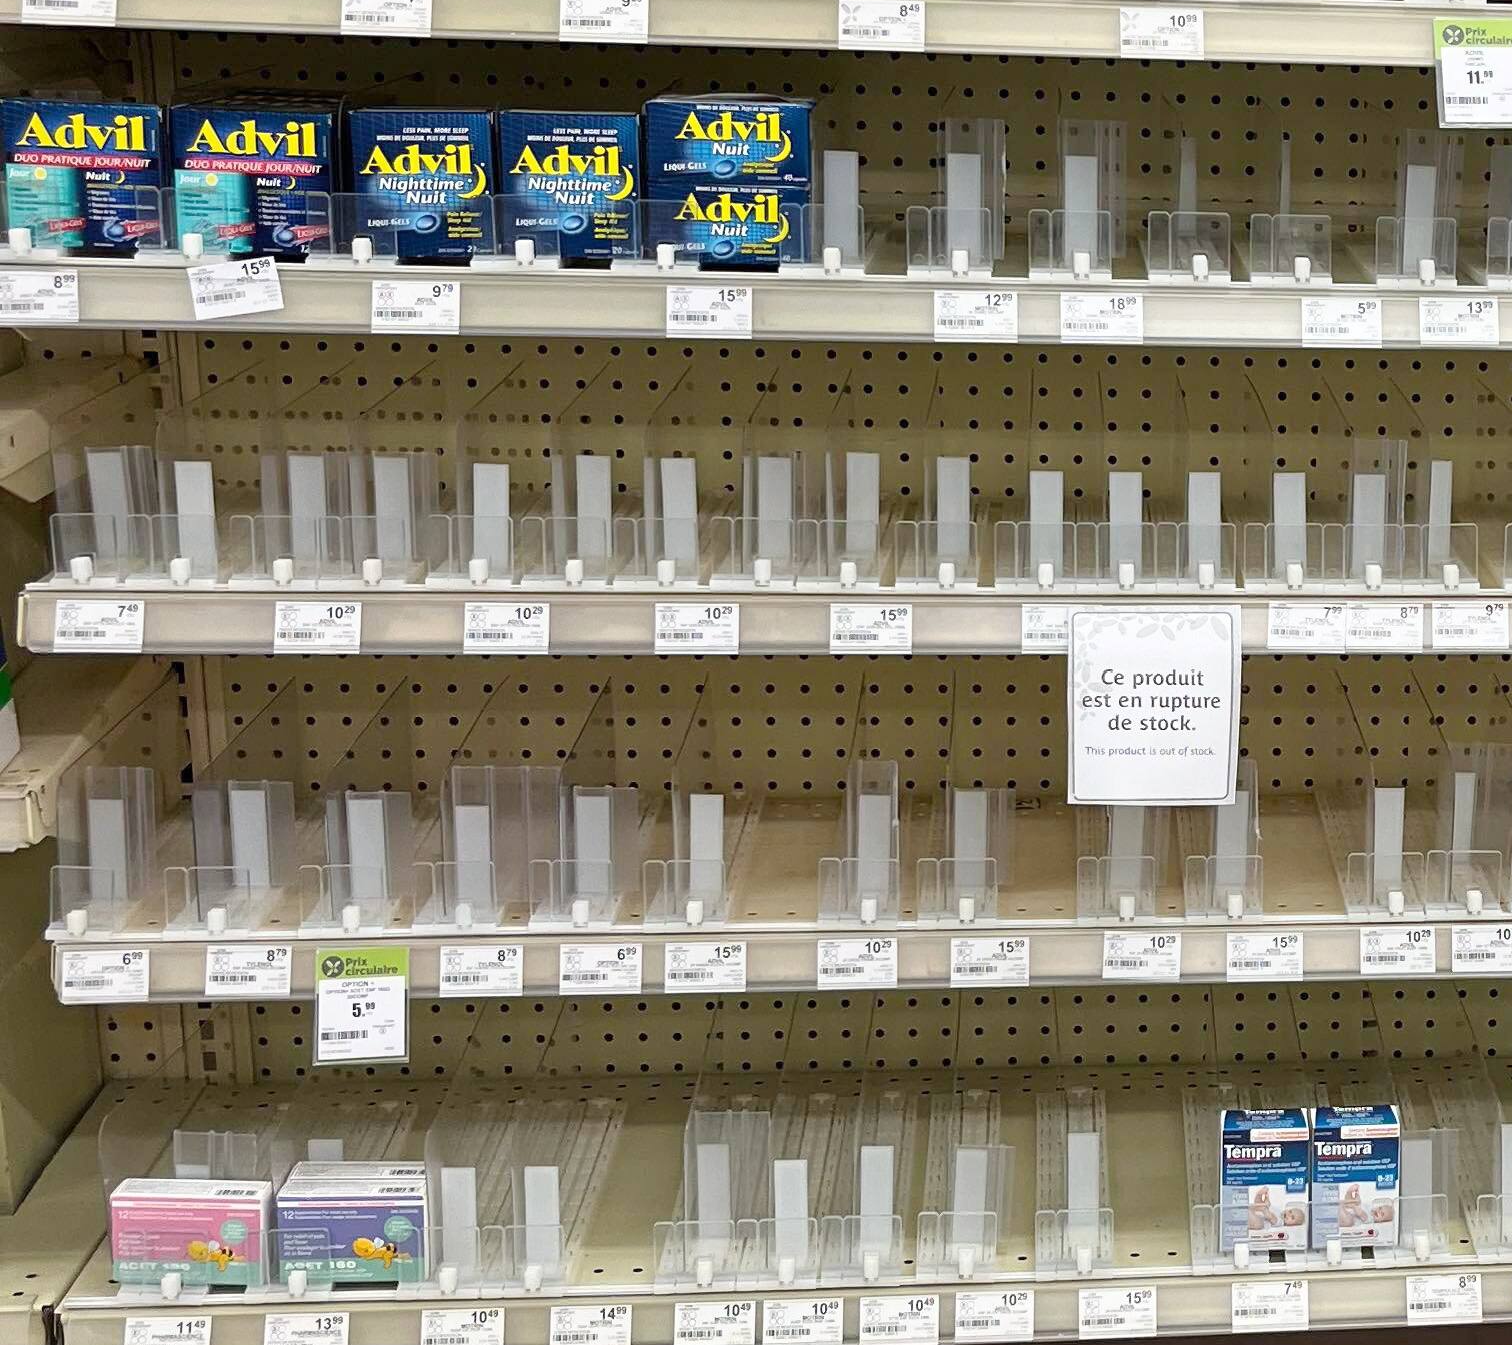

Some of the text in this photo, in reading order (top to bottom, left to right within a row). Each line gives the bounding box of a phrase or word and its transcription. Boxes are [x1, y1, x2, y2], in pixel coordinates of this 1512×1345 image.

[1465, 26, 1488, 38] Prix
[15, 111, 148, 151] Advil
[673, 111, 781, 143] Advil
[185, 118, 318, 158] Advil
[712, 141, 750, 157] Nuit
[13, 154, 151, 168] DUO PRATIQUE JOUR/NUIT
[359, 143, 473, 175] Advil
[85, 172, 111, 182] Nuit
[256, 177, 281, 188] Nuit
[379, 176, 465, 193] Nighttime
[527, 176, 612, 194] Nighttime
[405, 190, 447, 205] Nuit
[554, 190, 595, 205] Nuit
[673, 190, 780, 224] Advil
[710, 222, 749, 237] Nuit
[1101, 669, 1204, 689] Ce produit
[1082, 694, 1221, 712] est en rupture
[1108, 715, 1196, 731] de stock.
[1085, 746, 1216, 757] This product is out of stock.
[345, 956, 368, 967] Prix
[345, 964, 400, 977] circulaire
[1224, 1144, 1282, 1160] Tempra
[1314, 1141, 1372, 1157] Tempra
[285, 1261, 323, 1270] ACET
